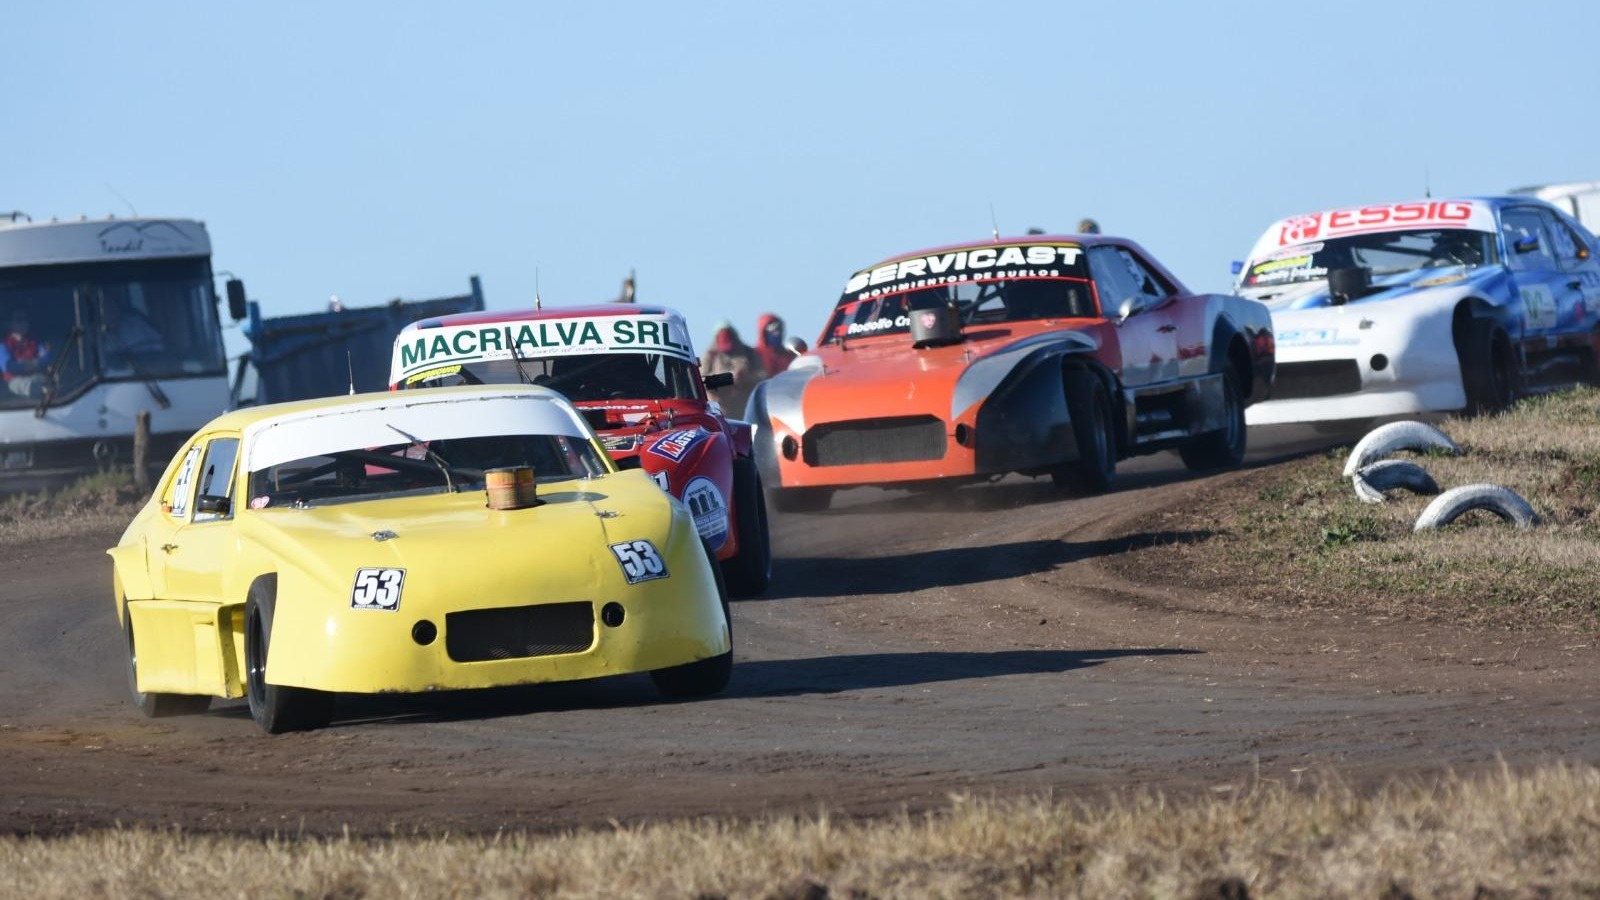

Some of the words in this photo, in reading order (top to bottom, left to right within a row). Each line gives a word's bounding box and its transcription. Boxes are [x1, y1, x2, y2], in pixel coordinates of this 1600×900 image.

[1328, 202, 1473, 229] ESSIG
[844, 246, 1084, 294] SERVICAST
[858, 274, 968, 301] MOVIMIENTOS
[973, 271, 993, 281] DE
[996, 269, 1060, 279] SUELOS
[847, 316, 893, 335] Rodolfo
[401, 321, 603, 369] MACRIALVA
[612, 541, 664, 577] 53
[354, 569, 402, 607] 53
